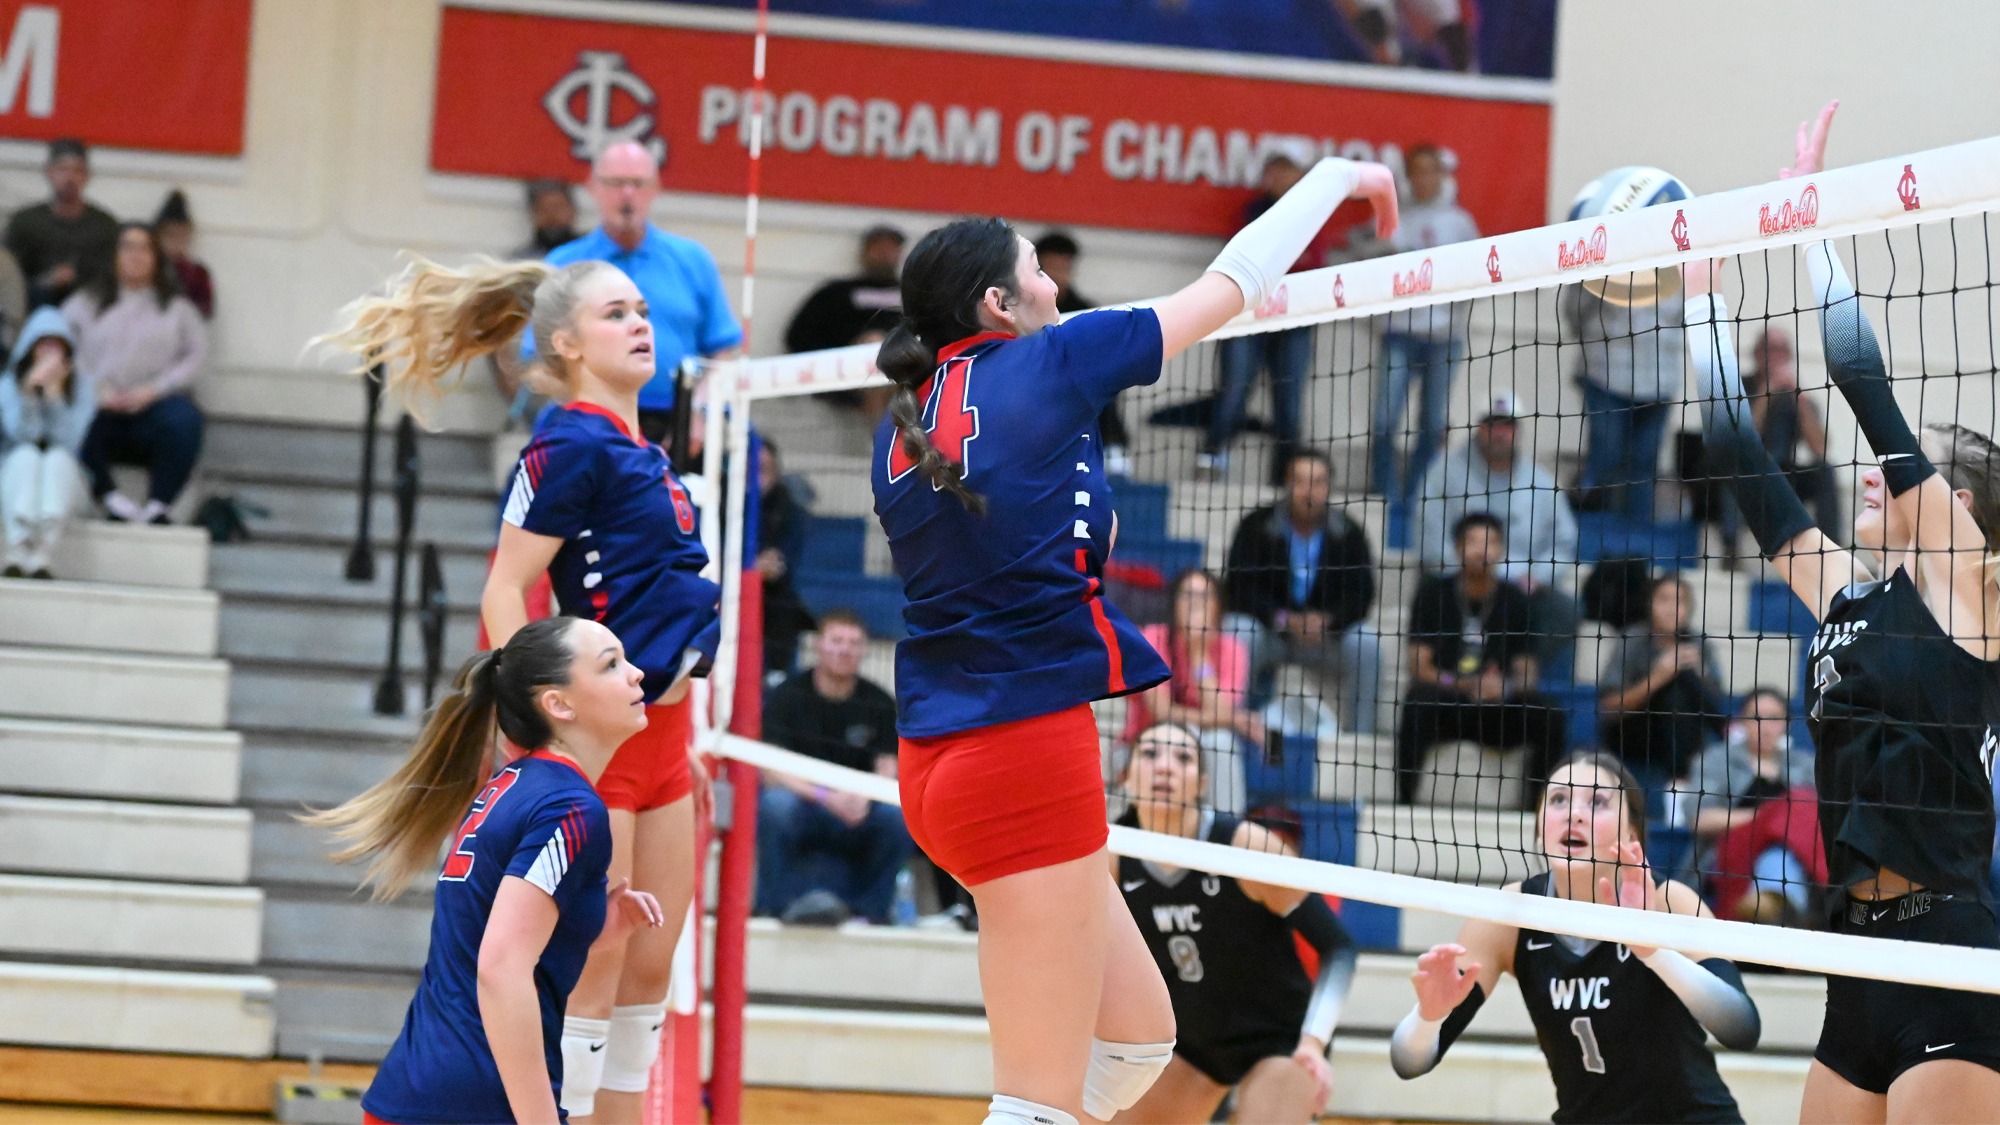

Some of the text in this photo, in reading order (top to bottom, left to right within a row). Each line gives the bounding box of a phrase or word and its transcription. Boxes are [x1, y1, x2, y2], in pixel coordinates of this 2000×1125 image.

[700, 84, 1000, 169] PROGRAM
[1015, 110, 1093, 175] OF
[886, 354, 980, 492] 4
[438, 766, 522, 882] 2
[1151, 903, 1203, 933] WVC
[1549, 975, 1611, 1011] WVC
[1569, 1015, 1607, 1075] 1
